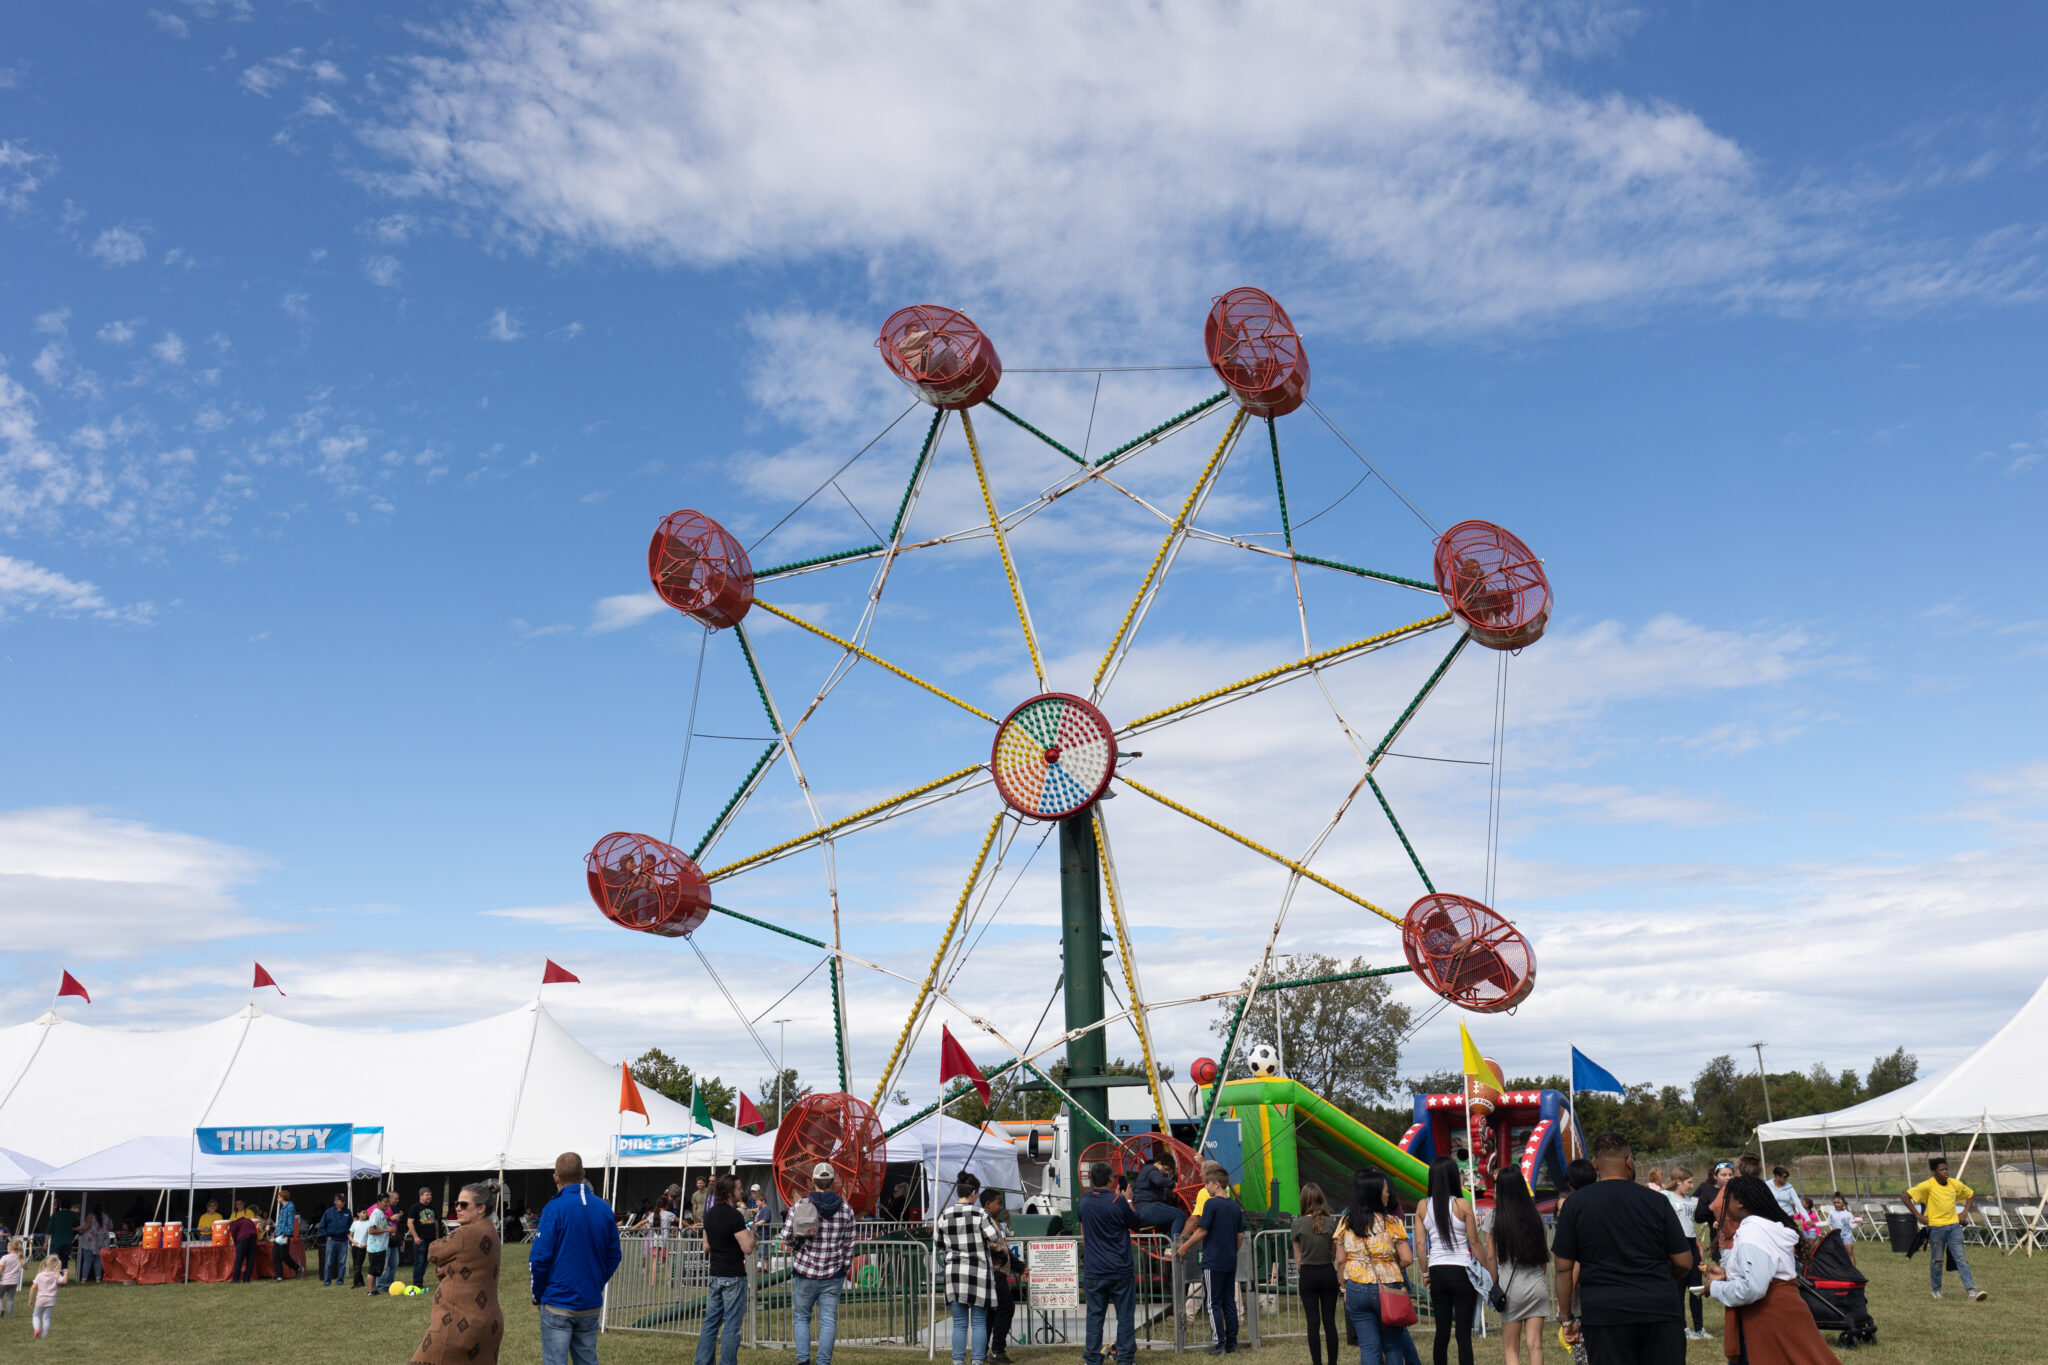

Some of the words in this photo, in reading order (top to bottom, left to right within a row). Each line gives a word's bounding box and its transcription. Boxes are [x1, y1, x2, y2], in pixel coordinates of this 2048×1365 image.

[216, 1128, 332, 1152] THIRSTY
[657, 1138, 667, 1149] &
[1055, 1242, 1074, 1250] SAFETY
